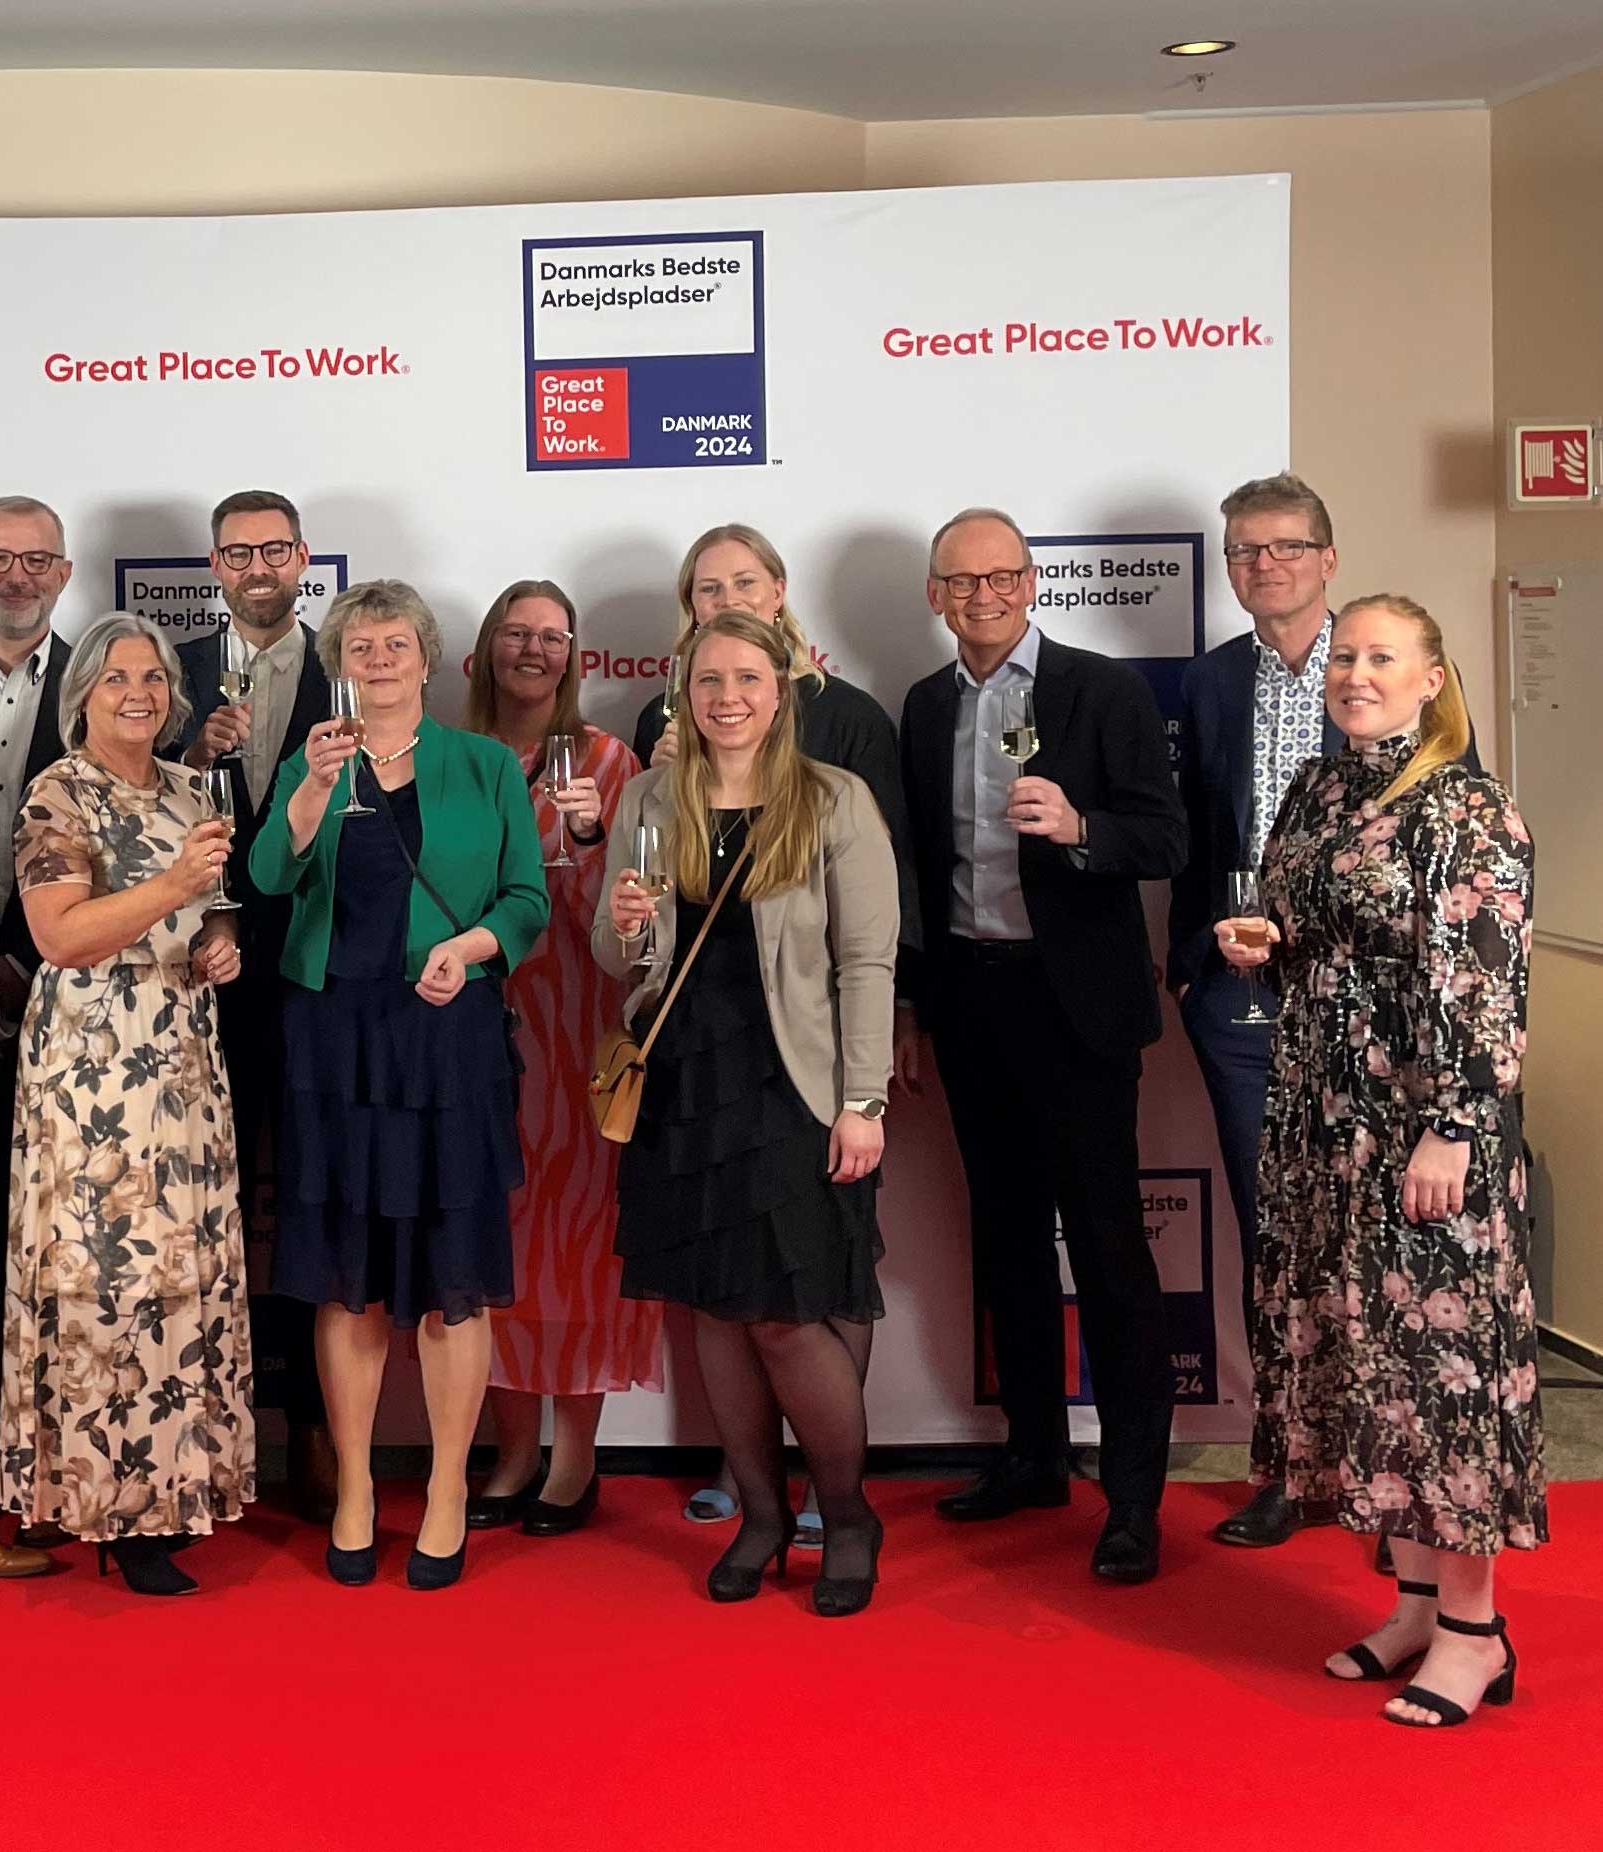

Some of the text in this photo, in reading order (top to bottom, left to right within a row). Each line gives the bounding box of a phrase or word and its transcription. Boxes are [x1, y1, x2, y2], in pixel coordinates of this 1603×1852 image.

[540, 256, 741, 281] Danmarks Bedste
[883, 327, 993, 358] Great
[1005, 323, 1109, 353] Place
[1114, 319, 1157, 350] To
[44, 352, 148, 383] Great
[159, 352, 257, 381] Place
[260, 349, 301, 379] To
[541, 375, 605, 394] Great
[543, 395, 605, 414] Place
[541, 415, 567, 433] To
[662, 414, 753, 433] DANMARK
[695, 435, 753, 457] 2024
[1037, 558, 1181, 579] arks Bedste
[133, 582, 221, 600] Danmar
[1174, 1375, 1204, 1395] 24
